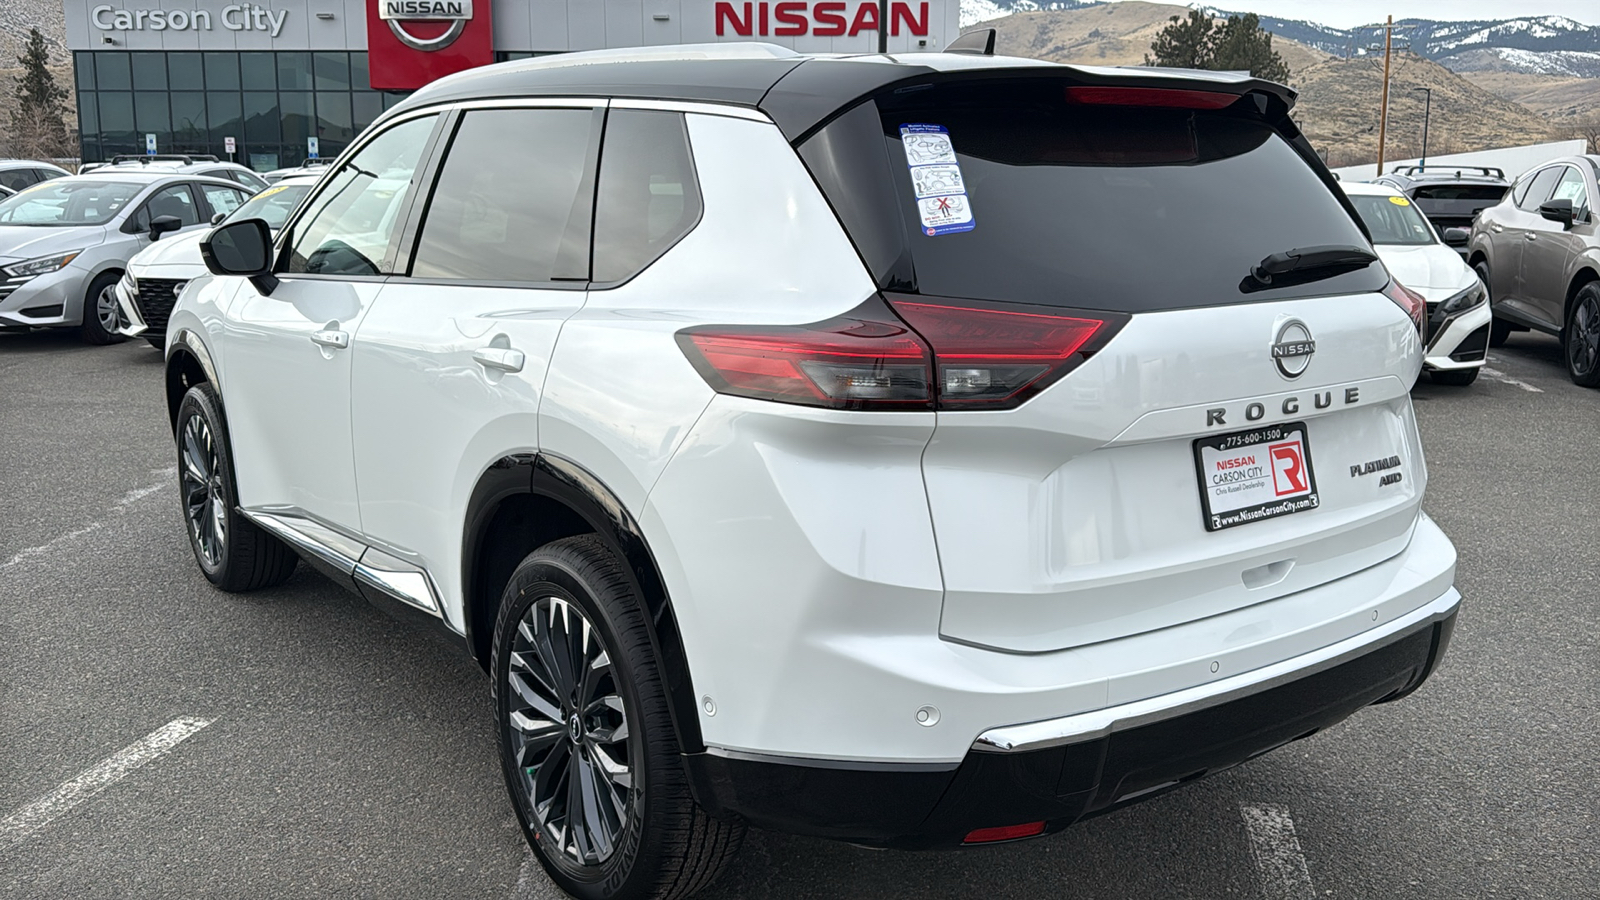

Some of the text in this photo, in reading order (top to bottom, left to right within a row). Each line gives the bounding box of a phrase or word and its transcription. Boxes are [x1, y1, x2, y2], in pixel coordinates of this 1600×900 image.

[387, 1, 462, 14] NISSAN
[91, 3, 289, 38] Carson City
[715, 1, 929, 37] NISSAN
[1274, 341, 1316, 356] NISSAN
[1206, 387, 1360, 427] ROGUE
[1226, 429, 1281, 447] 775-600-1500
[1216, 455, 1256, 471] NISSAN
[1350, 455, 1401, 478] PLATINUM
[1212, 466, 1263, 485] CARSON CITY
[1379, 472, 1402, 488] AWD
[1215, 481, 1266, 496] Chris Russell Dealership
[1221, 500, 1310, 526] www.NissanCarsonCity.com
